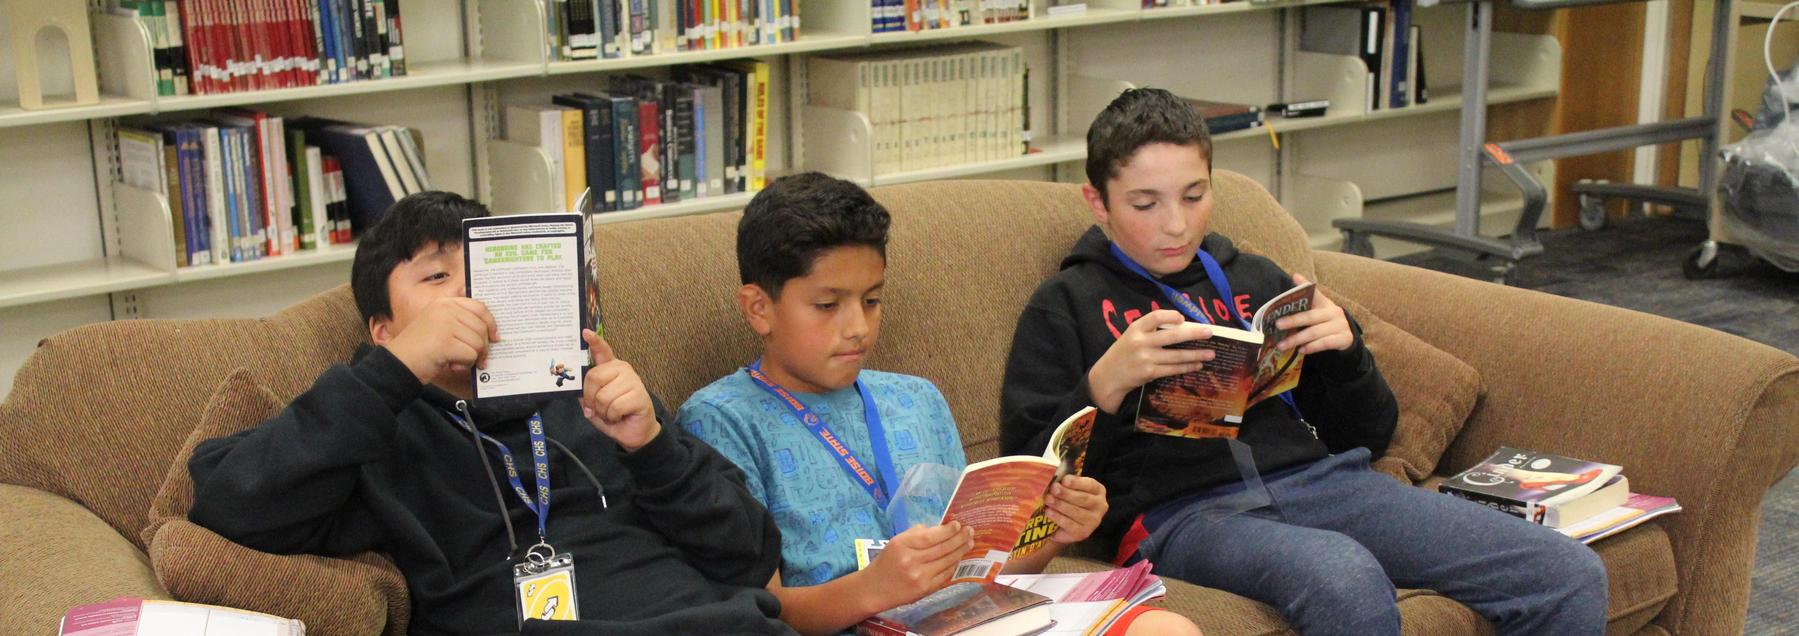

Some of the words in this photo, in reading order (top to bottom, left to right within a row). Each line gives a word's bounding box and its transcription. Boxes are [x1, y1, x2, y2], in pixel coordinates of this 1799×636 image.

[775, 387, 804, 411] BOISE
[530, 419, 543, 435] CHS
[534, 439, 545, 457] CHS
[818, 427, 848, 456] STATE
[503, 453, 518, 478] CHS
[515, 486, 532, 504] CHS
[537, 462, 548, 480] CHS
[845, 456, 876, 486] BOISE
[1008, 546, 1027, 561] STIN
